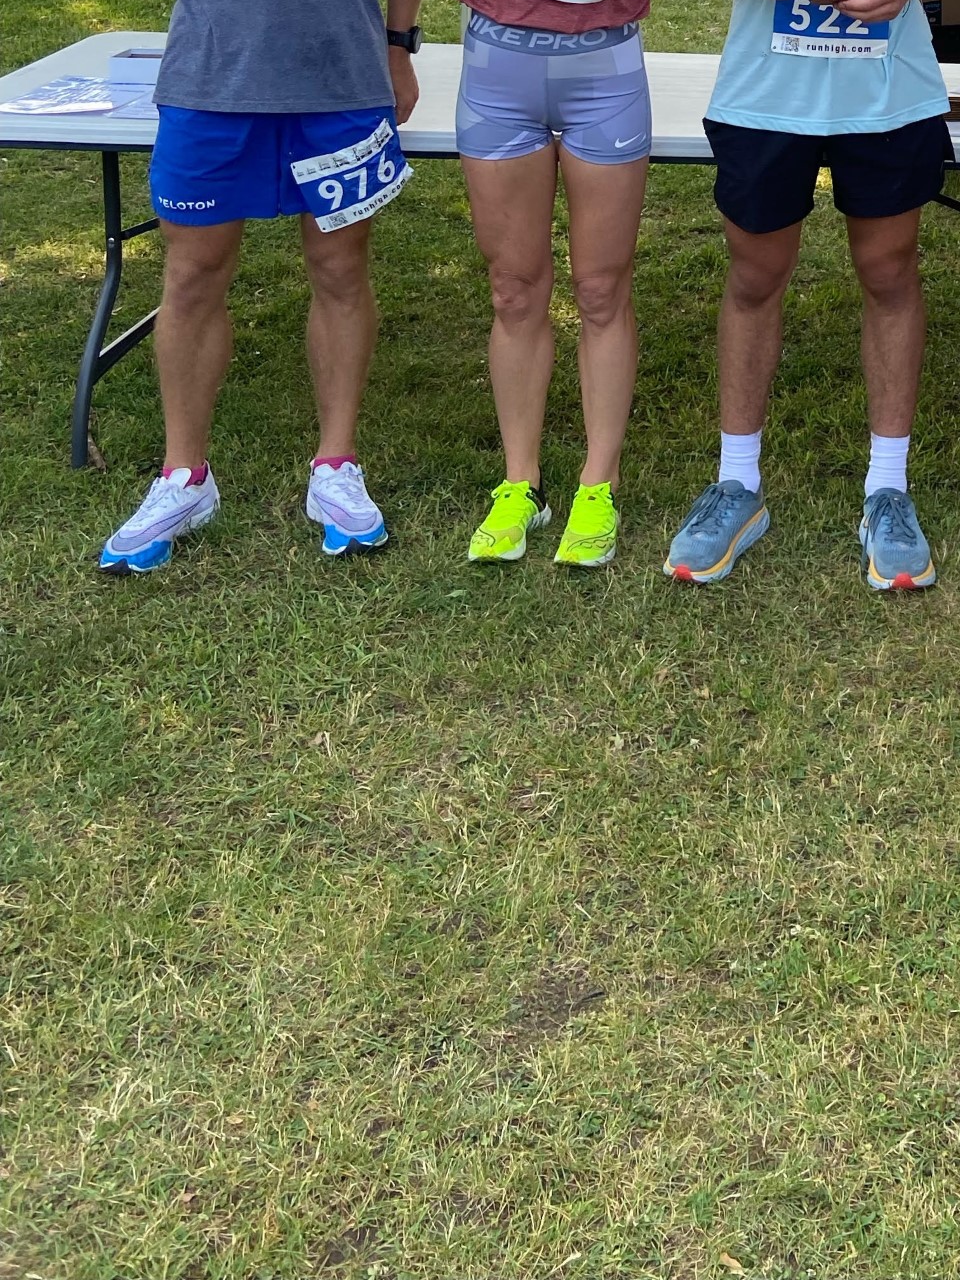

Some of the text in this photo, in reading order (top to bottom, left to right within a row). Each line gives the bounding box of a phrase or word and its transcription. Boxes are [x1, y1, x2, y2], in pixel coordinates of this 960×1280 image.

[528, 30, 607, 50] PRO
[806, 42, 872, 54] runhigh.com
[317, 150, 396, 211] 976
[353, 178, 406, 217] runhigh.com
